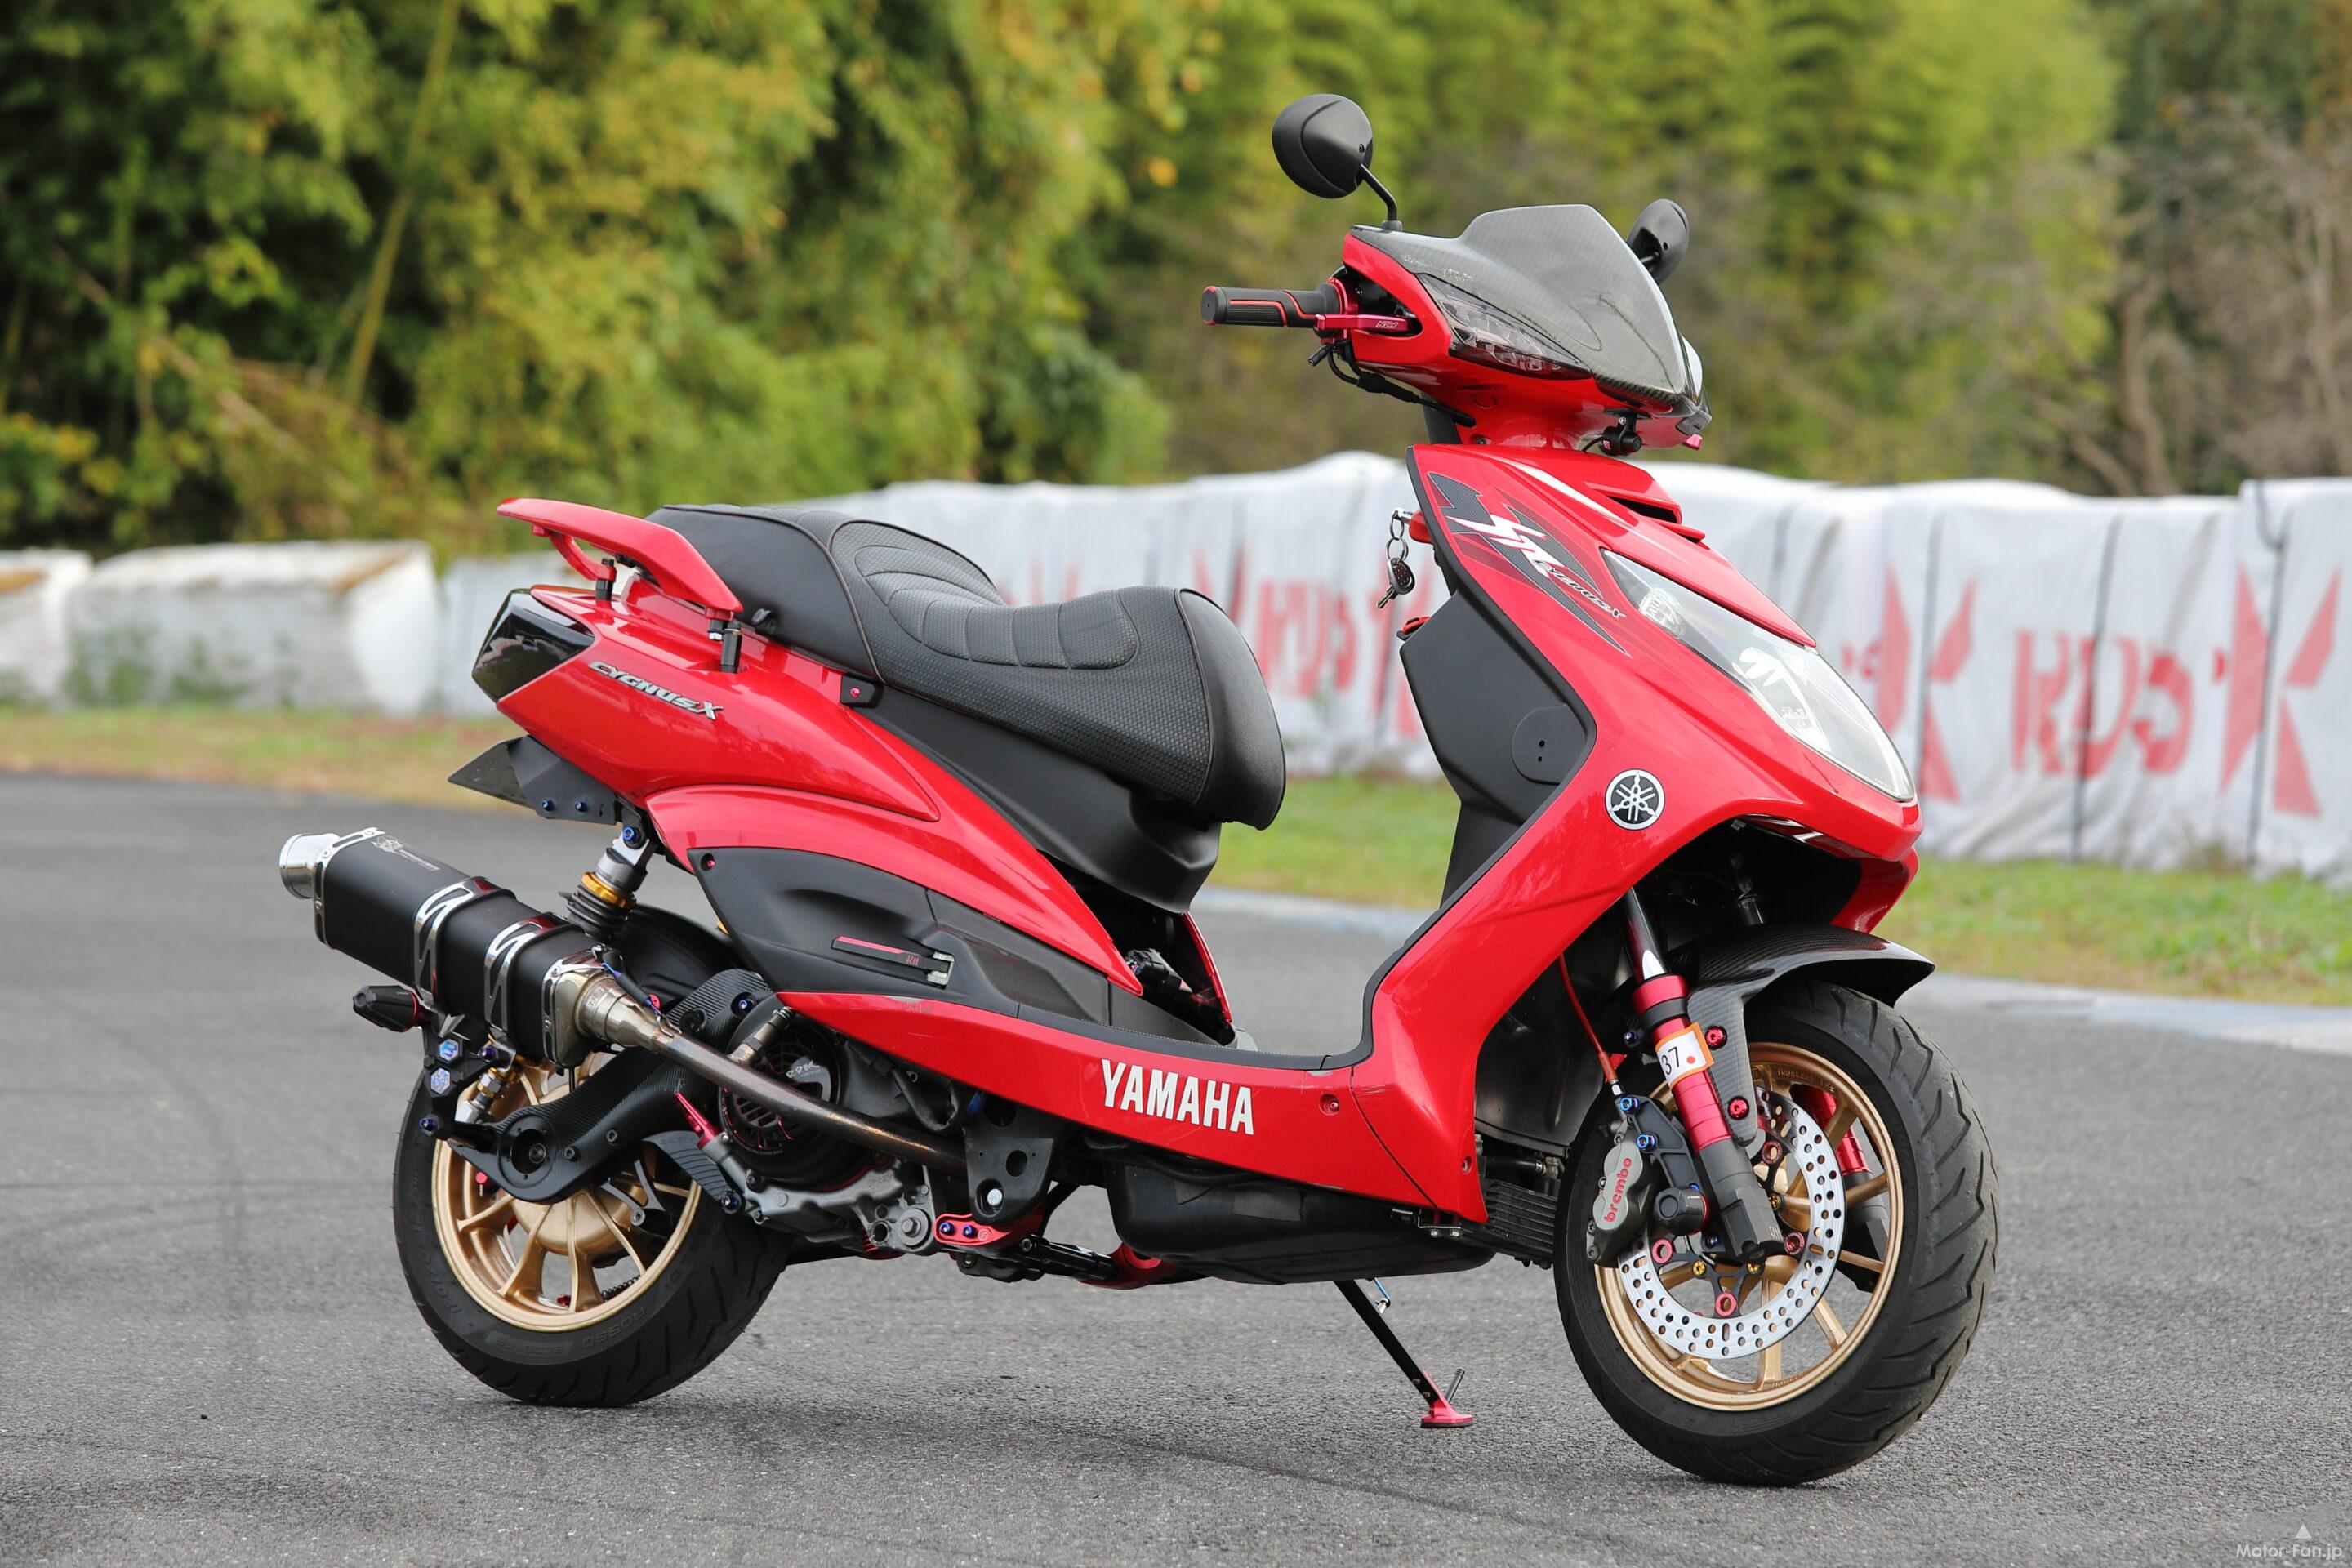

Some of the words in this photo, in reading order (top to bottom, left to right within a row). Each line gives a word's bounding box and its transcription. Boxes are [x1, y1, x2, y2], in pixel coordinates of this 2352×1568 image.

[1661, 1046, 1680, 1076] 37
[1102, 1058, 1254, 1136] YAMAHA
[1604, 1158, 1632, 1223] brembo
